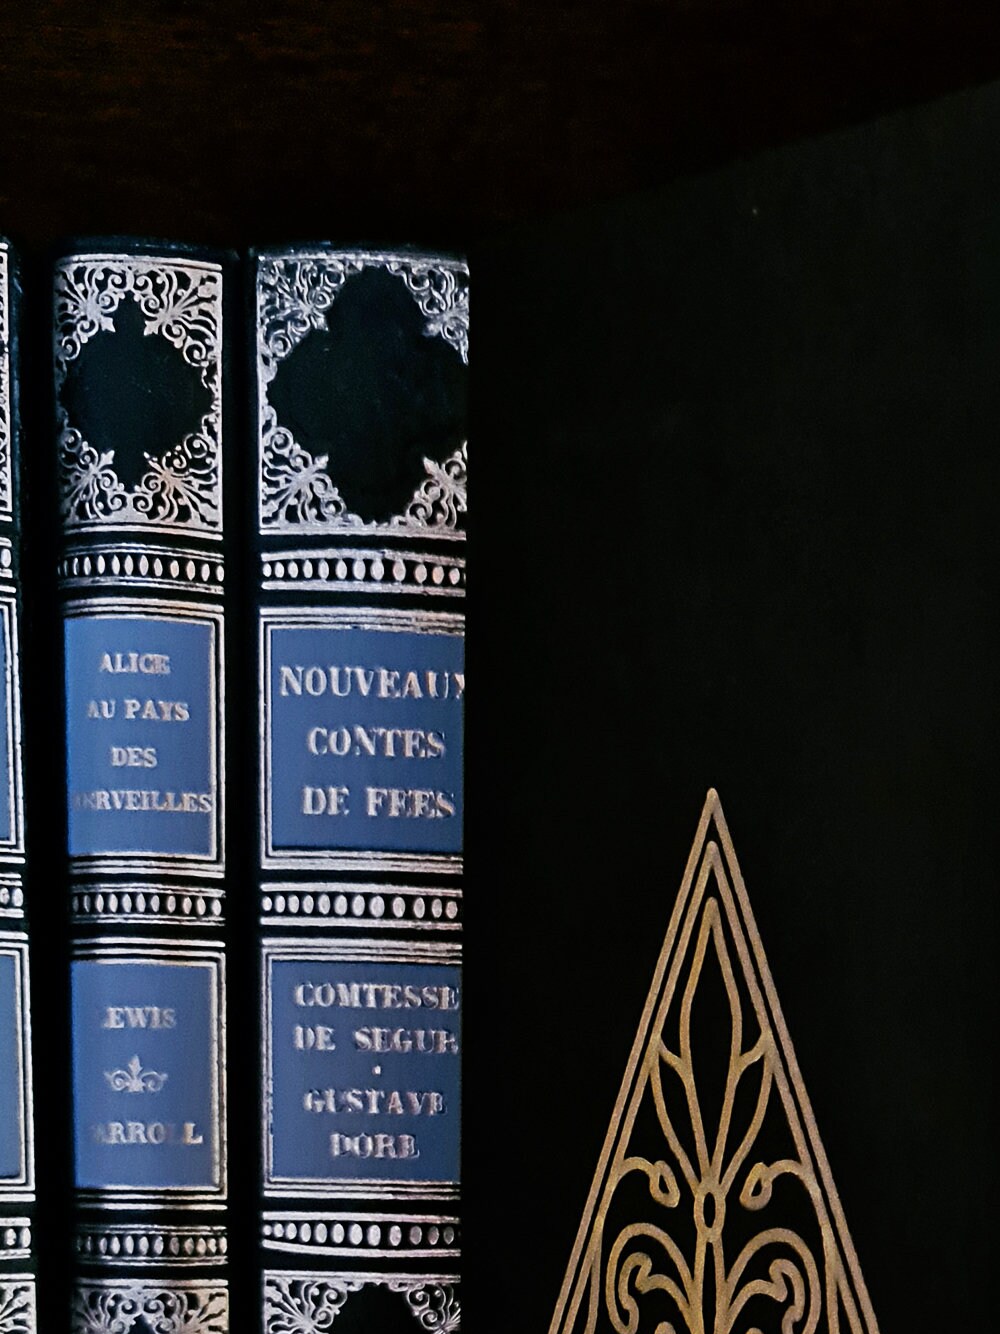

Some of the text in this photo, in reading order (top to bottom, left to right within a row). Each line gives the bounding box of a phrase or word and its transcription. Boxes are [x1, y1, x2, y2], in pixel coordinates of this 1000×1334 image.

[100, 652, 171, 675] ALICE
[86, 701, 191, 722] AU PAYS
[307, 725, 447, 759] CONTES
[111, 746, 158, 769] DES
[75, 788, 213, 813] RVEILLES
[303, 785, 457, 819] DE FEES
[294, 981, 460, 1010] COMTESSE
[101, 1006, 178, 1029] EWIS
[293, 1024, 460, 1054] DE SEGUR
[329, 1132, 420, 1159] DORE
